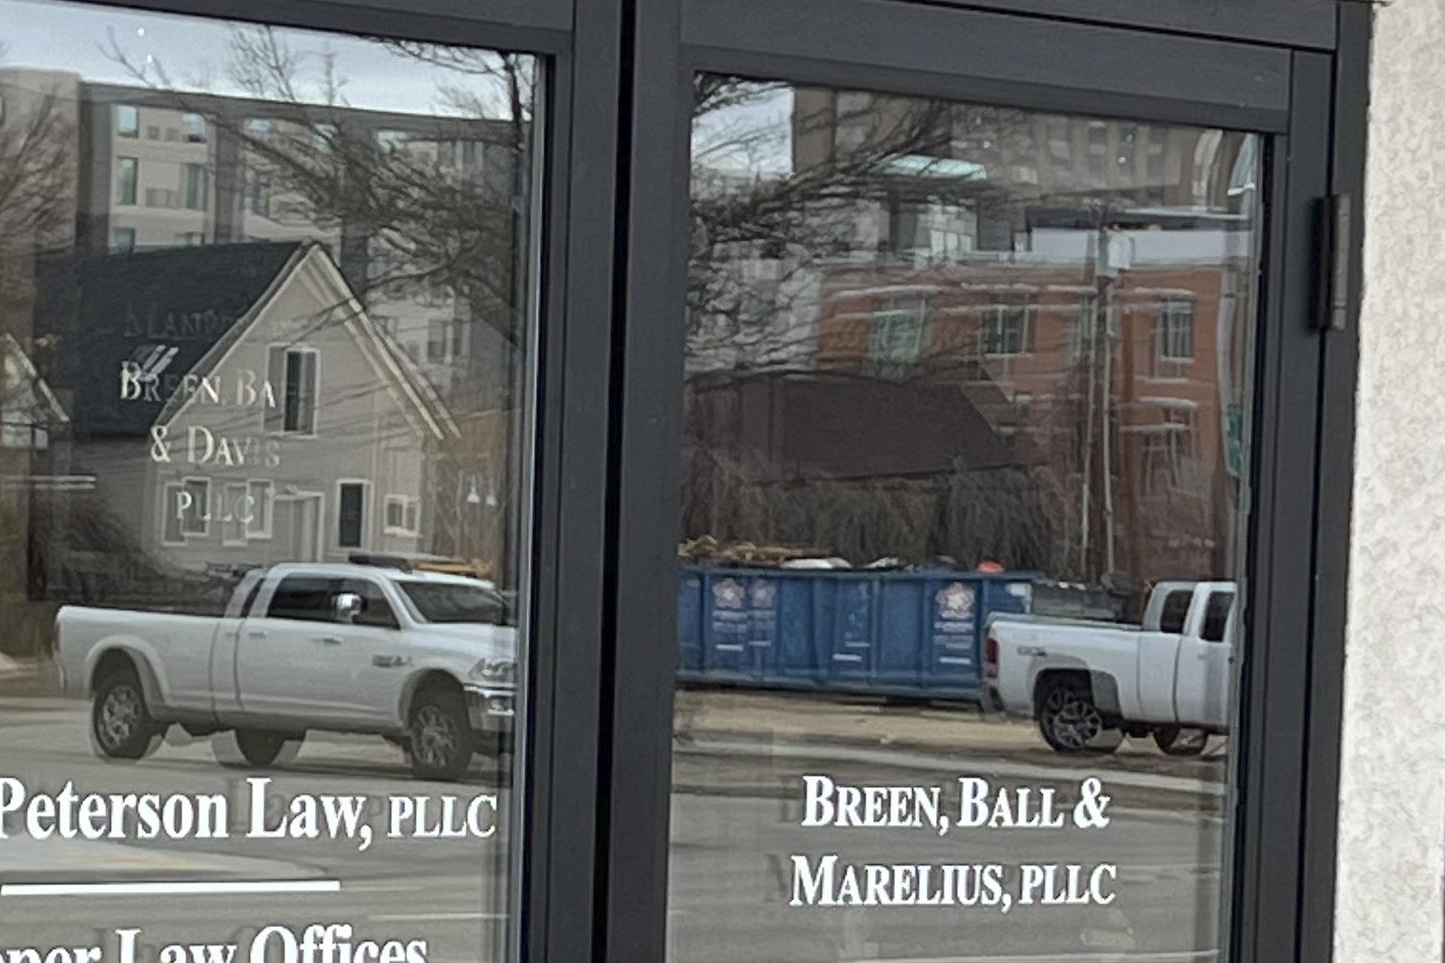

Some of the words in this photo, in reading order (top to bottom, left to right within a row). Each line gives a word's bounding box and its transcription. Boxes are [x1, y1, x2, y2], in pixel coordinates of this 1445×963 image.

[150, 425, 171, 463] &
[176, 491, 255, 524] PLLC
[245, 777, 372, 851] Law,
[387, 794, 498, 838] PLLC
[801, 775, 950, 836] BREEN,
[956, 777, 1065, 828] BALL
[1073, 777, 1111, 829] &
[789, 854, 1012, 913] MARELIUS,
[1018, 864, 1117, 905] PLLC
